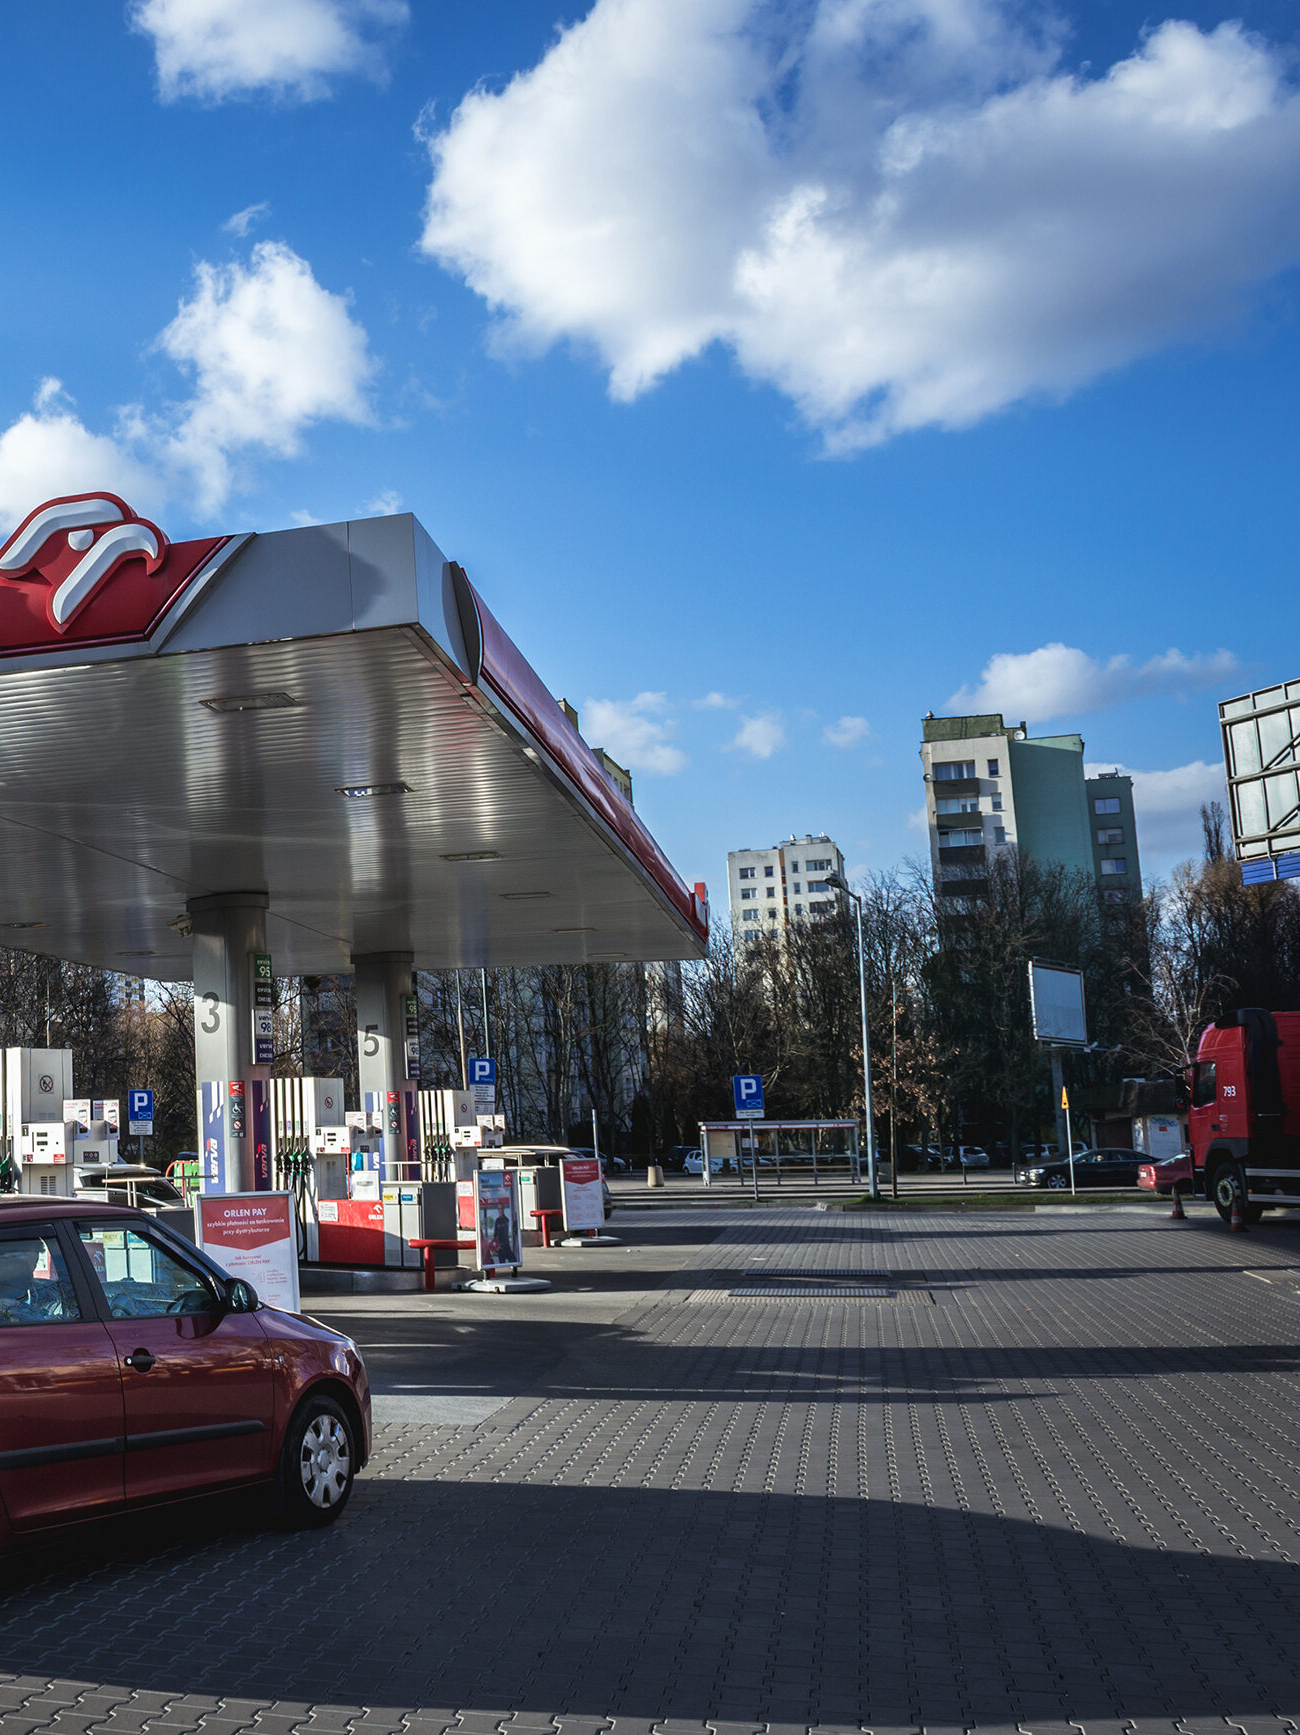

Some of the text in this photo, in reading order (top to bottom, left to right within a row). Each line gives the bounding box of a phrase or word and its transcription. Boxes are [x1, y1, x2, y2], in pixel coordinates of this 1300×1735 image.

[259, 966, 270, 977] 95
[201, 991, 220, 1034] 3
[260, 1022, 271, 1033] 98
[363, 1024, 380, 1057] 5
[475, 1061, 490, 1081] P
[740, 1078, 757, 1100] P
[1223, 1085, 1237, 1097] 793
[134, 1092, 148, 1112] P
[210, 1137, 219, 1184] verva
[260, 1143, 268, 1179] verva
[223, 1207, 267, 1218] ORLEN PAY
[206, 1220, 226, 1228] szybkie
